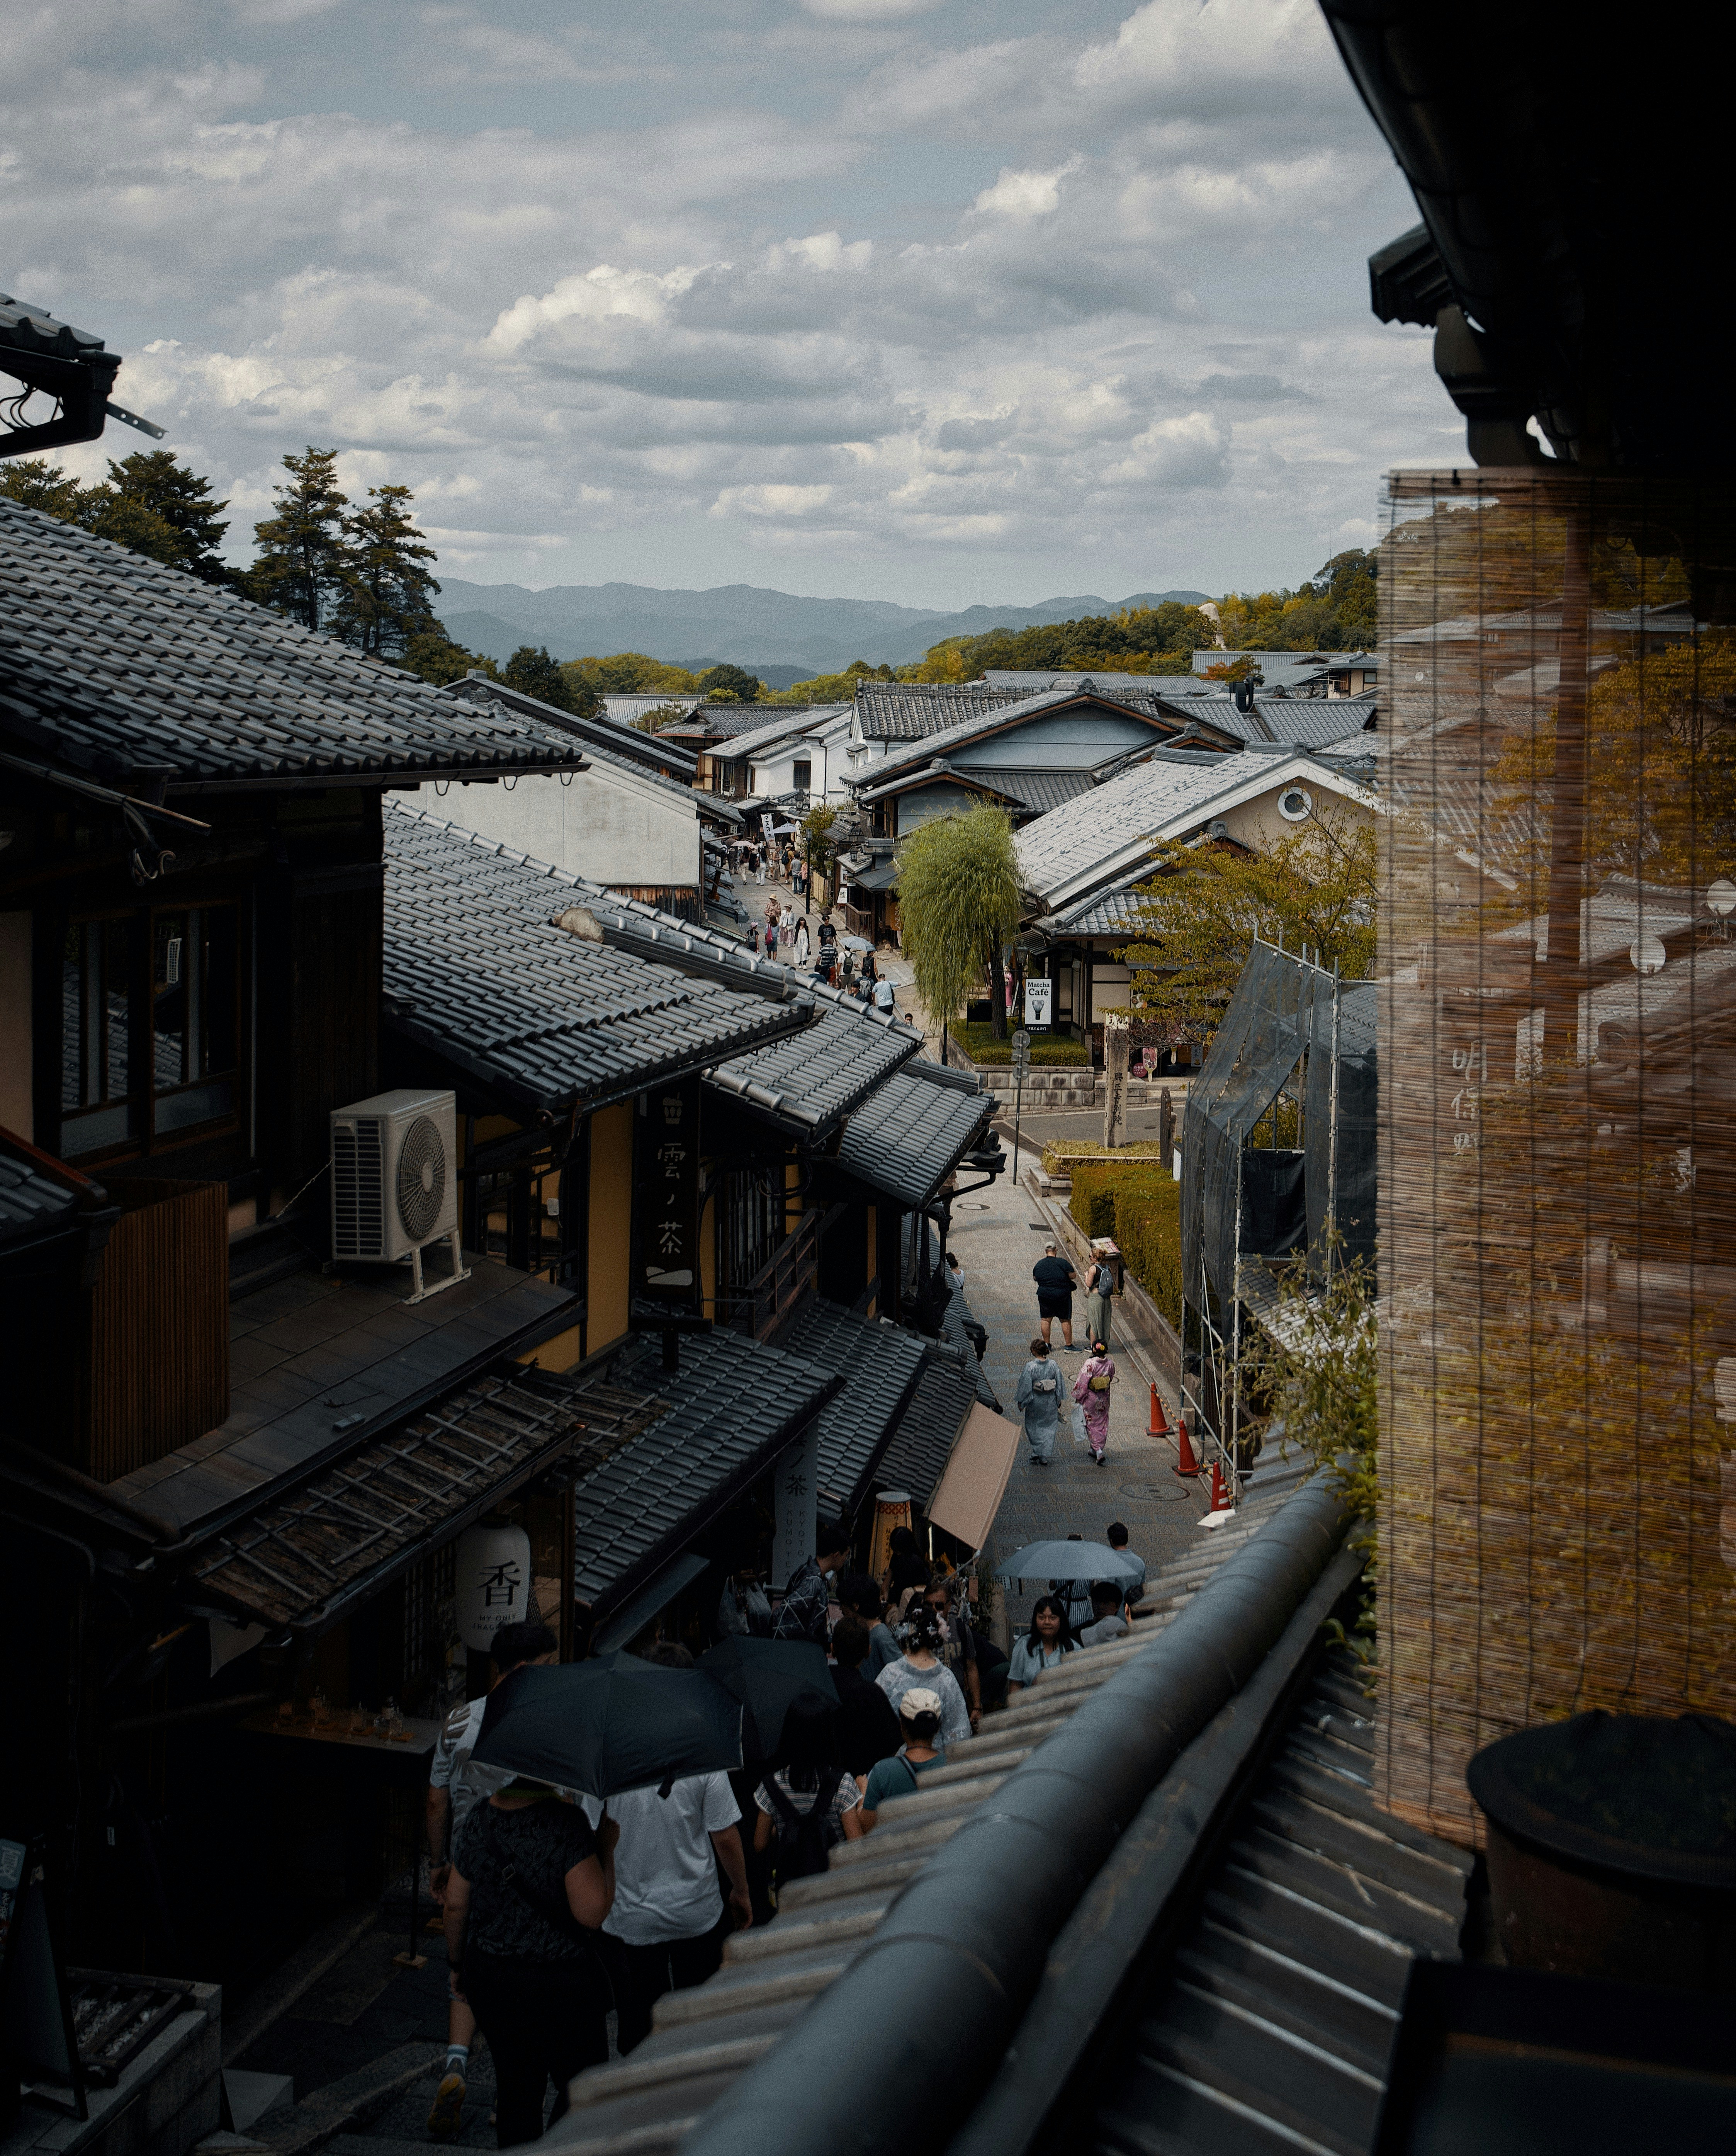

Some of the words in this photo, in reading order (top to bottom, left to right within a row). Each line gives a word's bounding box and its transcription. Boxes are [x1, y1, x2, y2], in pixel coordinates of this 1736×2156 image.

[1113, 1072, 1123, 1125] 興正寺別院
[657, 1143, 686, 1254] 雲ノ茶
[476, 1560, 521, 1607] 香
